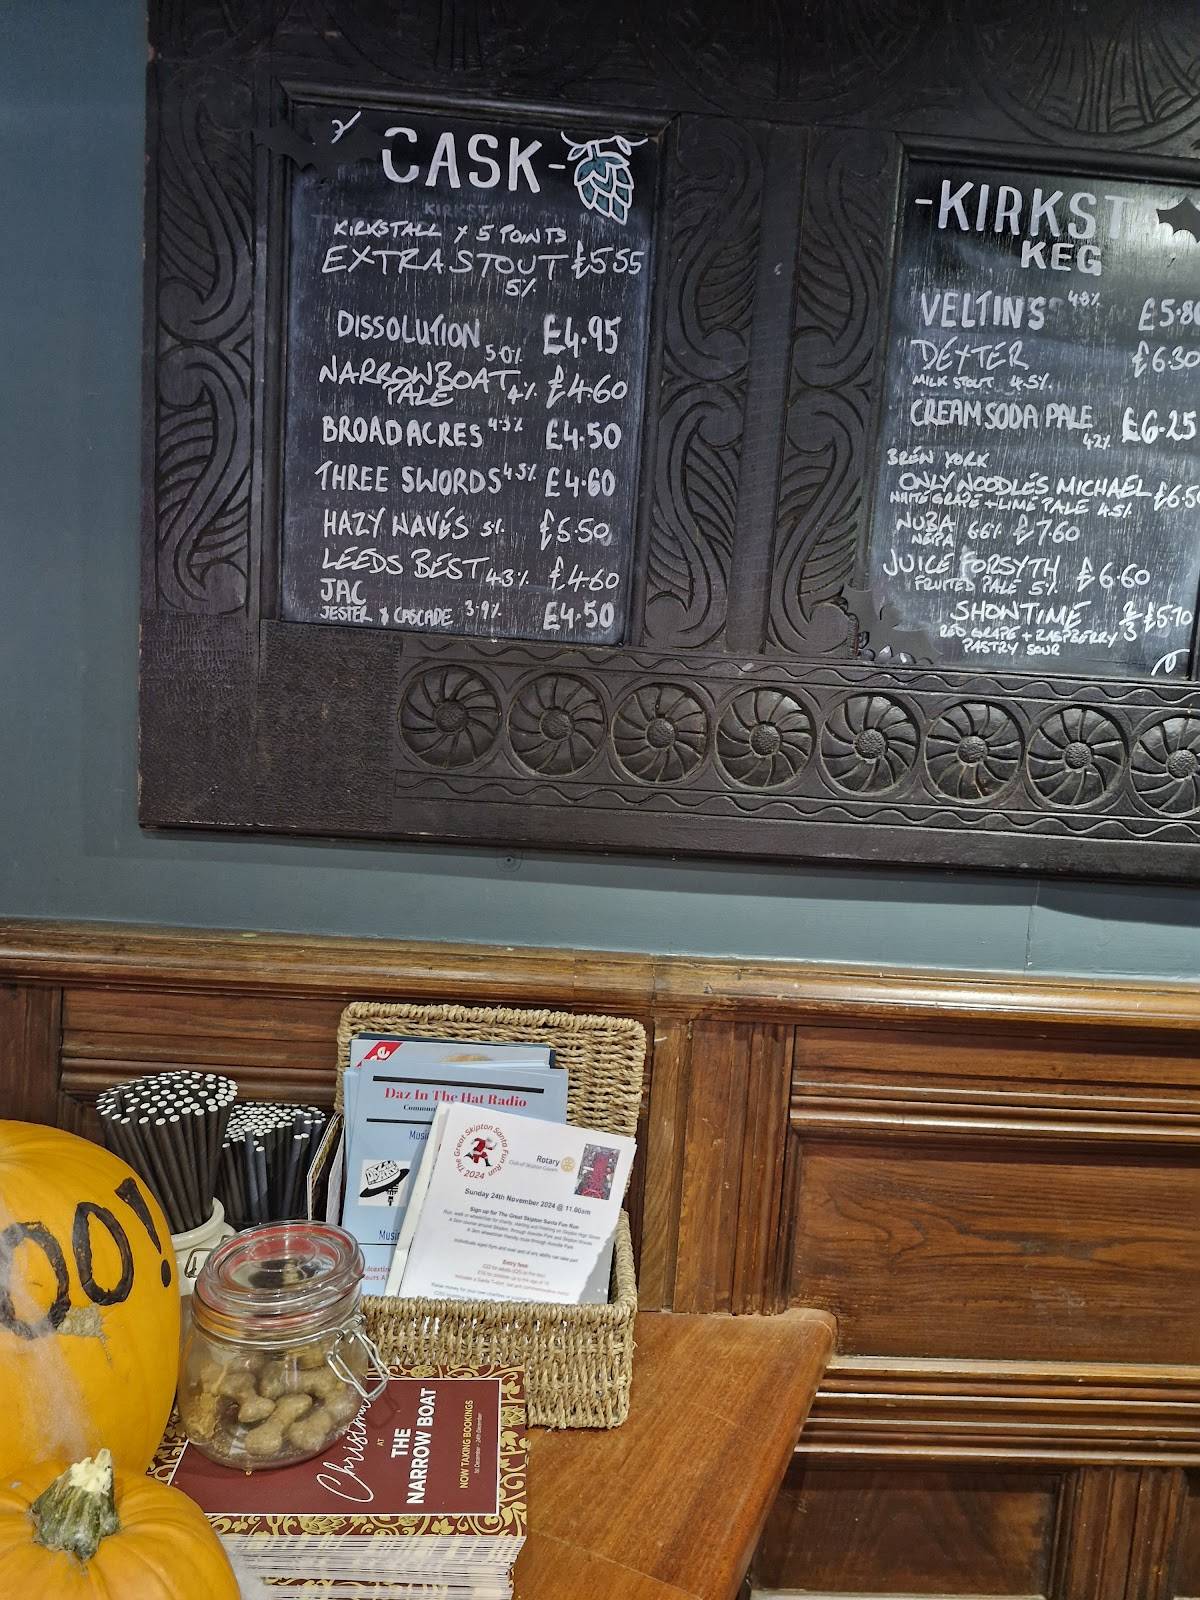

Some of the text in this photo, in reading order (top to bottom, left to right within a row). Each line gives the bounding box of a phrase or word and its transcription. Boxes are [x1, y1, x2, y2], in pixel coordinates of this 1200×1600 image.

[333, 219, 441, 238] KIRKSTALL
[476, 225, 495, 240] 5
[500, 224, 566, 244] POINTS
[322, 245, 444, 274] EXTRA
[449, 249, 569, 280] STOUT
[1020, 240, 1101, 276] KEG
[505, 279, 537, 297] 5%
[921, 291, 1046, 330] VELTINS
[337, 310, 480, 349] DISSOLUTION
[910, 336, 1029, 374] DEXTER
[319, 355, 521, 393] NARROWBOAT
[912, 374, 948, 387] MILK
[953, 375, 994, 389] STOUT
[382, 381, 454, 407] PALE
[910, 399, 979, 428] CREAM
[985, 399, 1038, 430] SODA
[1046, 401, 1093, 430] PALE
[322, 416, 483, 448] BROADACRES
[945, 450, 990, 468] YORK
[314, 461, 389, 492] THREE
[401, 465, 502, 496] SWORDS
[900, 470, 955, 492] ONLY
[956, 472, 1049, 497] NOODLES
[1057, 474, 1152, 498] MICHAEL
[999, 497, 1038, 512] LIME
[1041, 497, 1089, 516] PALE
[323, 507, 386, 538] HAZY
[392, 506, 469, 541] WAVES
[322, 547, 404, 575] LEEDS
[411, 549, 490, 581] BEST
[883, 549, 955, 577] JUICE
[961, 550, 1061, 580] FORSYTH
[982, 575, 1023, 595] PALE
[394, 607, 453, 628] CASCADE
[962, 639, 1019, 656] PASTRY
[385, 1087, 527, 1108] Daz In The Hat Radio
[463, 1169, 486, 1181] 2024
[536, 1154, 560, 1168] Rotary
[464, 1187, 490, 1200] Sunday
[490, 1191, 505, 1202] 24th
[506, 1195, 540, 1208] November
[376, 1437, 385, 1447] AT
[390, 1427, 412, 1459] THE
[406, 1388, 437, 1504] NARROW BOAT
[459, 1399, 474, 1489] NOW TAKING BOOKINGS
